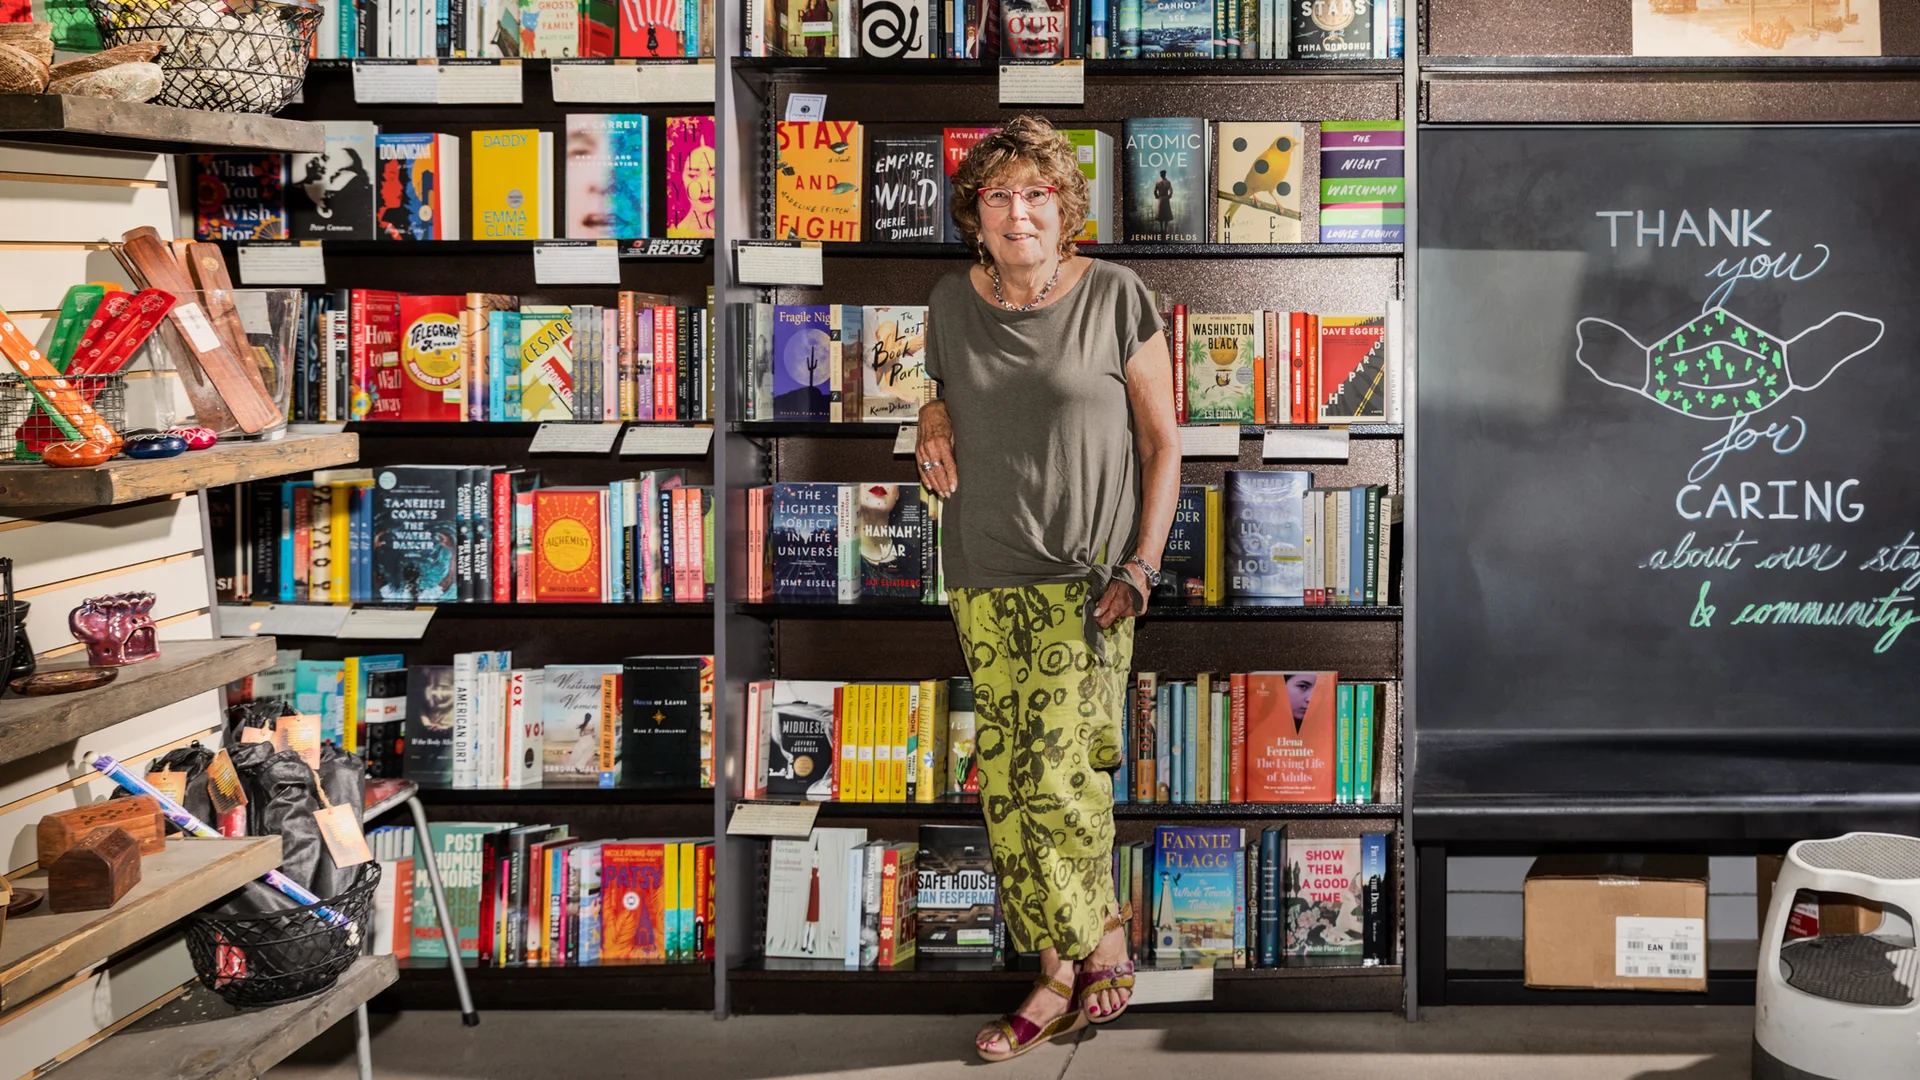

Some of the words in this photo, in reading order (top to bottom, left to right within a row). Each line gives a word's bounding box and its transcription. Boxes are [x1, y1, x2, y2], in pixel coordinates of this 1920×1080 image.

[538, 0, 575, 10] GHOSTS
[1157, 2, 1197, 11] CANNOT
[1302, 0, 1367, 17] STARS
[542, 21, 574, 31] FAMILY
[1008, 15, 1058, 34] OUR
[1008, 36, 1060, 54] WAR
[1297, 44, 1320, 52] EMMA
[1323, 42, 1372, 52] DONOGHUE
[592, 120, 638, 129] CARREY
[684, 122, 703, 142] IF
[777, 122, 856, 150] STAY
[1353, 134, 1370, 143] THE
[483, 134, 528, 147] DADDY
[1126, 134, 1201, 149] ATOMIC
[380, 143, 431, 160] DOMINICANA
[875, 151, 935, 174] EMPIRE
[1139, 153, 1188, 168] LOVE
[1341, 157, 1387, 172] NIGHT
[205, 161, 255, 177] What
[911, 169, 920, 181] OF
[795, 175, 839, 190] AND
[223, 184, 258, 199] You
[875, 179, 938, 211] WILD
[1327, 184, 1398, 198] WATCHMAN
[222, 204, 271, 221] Wish
[483, 211, 527, 223] EMMA
[779, 215, 858, 240] FIGHT
[875, 217, 906, 229] CHERIE
[1596, 208, 1773, 247] THANK
[221, 226, 254, 240] For
[485, 224, 526, 237] CLINE
[891, 226, 935, 240] DIMALINE
[1131, 233, 1162, 241] JENNIE
[1165, 233, 1197, 241] FIELDS
[1326, 228, 1362, 239] LOUISE
[1364, 227, 1400, 240] ERDRICH
[647, 245, 702, 255] READS
[1703, 244, 1830, 314] you
[655, 309, 663, 330] TRUST
[666, 309, 674, 330] TRUST
[779, 312, 811, 325] Fragile
[901, 312, 913, 321] The
[365, 325, 394, 345] How
[894, 320, 925, 342] Last
[1192, 323, 1254, 336] WASHINGTON
[1322, 327, 1347, 336] DAVE
[1349, 327, 1385, 336] EGGERS
[655, 333, 663, 363] EXERCISE
[666, 333, 674, 363] EXERCISE
[1208, 337, 1239, 350] BLACK
[369, 351, 383, 367] to
[871, 342, 913, 372] Book
[1204, 410, 1213, 419] ESI
[1214, 410, 1243, 419] EDUGYAN
[1687, 415, 1806, 483] for
[480, 481, 488, 519] TA-NEHISI
[797, 490, 821, 500] THE
[1676, 479, 1866, 523] CARING
[385, 498, 446, 510] TA-NEHISI
[780, 504, 839, 514] LIGHTEST
[1381, 502, 1391, 520] The
[391, 510, 438, 520] COATES
[1176, 511, 1200, 523] DER
[404, 521, 424, 530] THE
[786, 519, 832, 528] OBJECT
[395, 531, 432, 541] WATER
[787, 532, 800, 542] IN
[808, 532, 831, 542] THE
[865, 524, 921, 538] HANNAH'S
[1381, 523, 1391, 546] Book
[392, 541, 435, 550] DANCER
[546, 536, 590, 548] ALCHEMIST
[778, 546, 839, 557] UNIVERSE
[880, 544, 906, 557] WAR
[1380, 552, 1389, 562] of
[1638, 531, 1759, 570] about
[1755, 542, 1847, 571] our
[480, 553, 488, 580] WATER
[780, 579, 802, 588] KIMI
[806, 579, 836, 588] EISELE
[865, 578, 879, 587] JAN
[880, 578, 921, 588] ELIASBERG
[1689, 581, 1717, 628] &
[1731, 587, 1920, 654] community
[513, 675, 522, 706] VOX
[559, 694, 600, 710] Women
[456, 687, 467, 738] AMERICAN
[1140, 679, 1152, 751] ERNESTO
[1277, 737, 1303, 746] Elena
[456, 741, 467, 763] DIRT
[1266, 746, 1314, 757] Ferrante
[1256, 758, 1275, 768] The
[1276, 758, 1305, 771] Lying
[1305, 758, 1325, 768] Life
[1266, 772, 1278, 782] of
[1279, 772, 1313, 782] Adults
[445, 833, 484, 852] POST
[1161, 832, 1231, 849] FANNIE
[775, 846, 801, 854] Ferrante
[1305, 850, 1345, 861] SHOW
[1165, 851, 1228, 868] FLAGG
[1236, 854, 1244, 880] FANNIE
[1307, 864, 1343, 875] THEM
[604, 866, 662, 889] PATSY
[917, 874, 946, 890] SAFE
[951, 874, 995, 890] HOUSE
[1302, 878, 1311, 889] A
[1313, 878, 1349, 889] GOOD
[918, 891, 937, 904] DAN
[939, 891, 995, 904] FESPERMA
[1174, 886, 1202, 897] Whole
[1203, 886, 1232, 898] Town's
[1236, 881, 1244, 904] FLAGG
[1311, 892, 1341, 903] TIME
[1188, 900, 1220, 911] Talking
[551, 895, 560, 938] CANTORAS
[1305, 944, 1324, 952] Nicole
[1647, 943, 1663, 951] EAN
